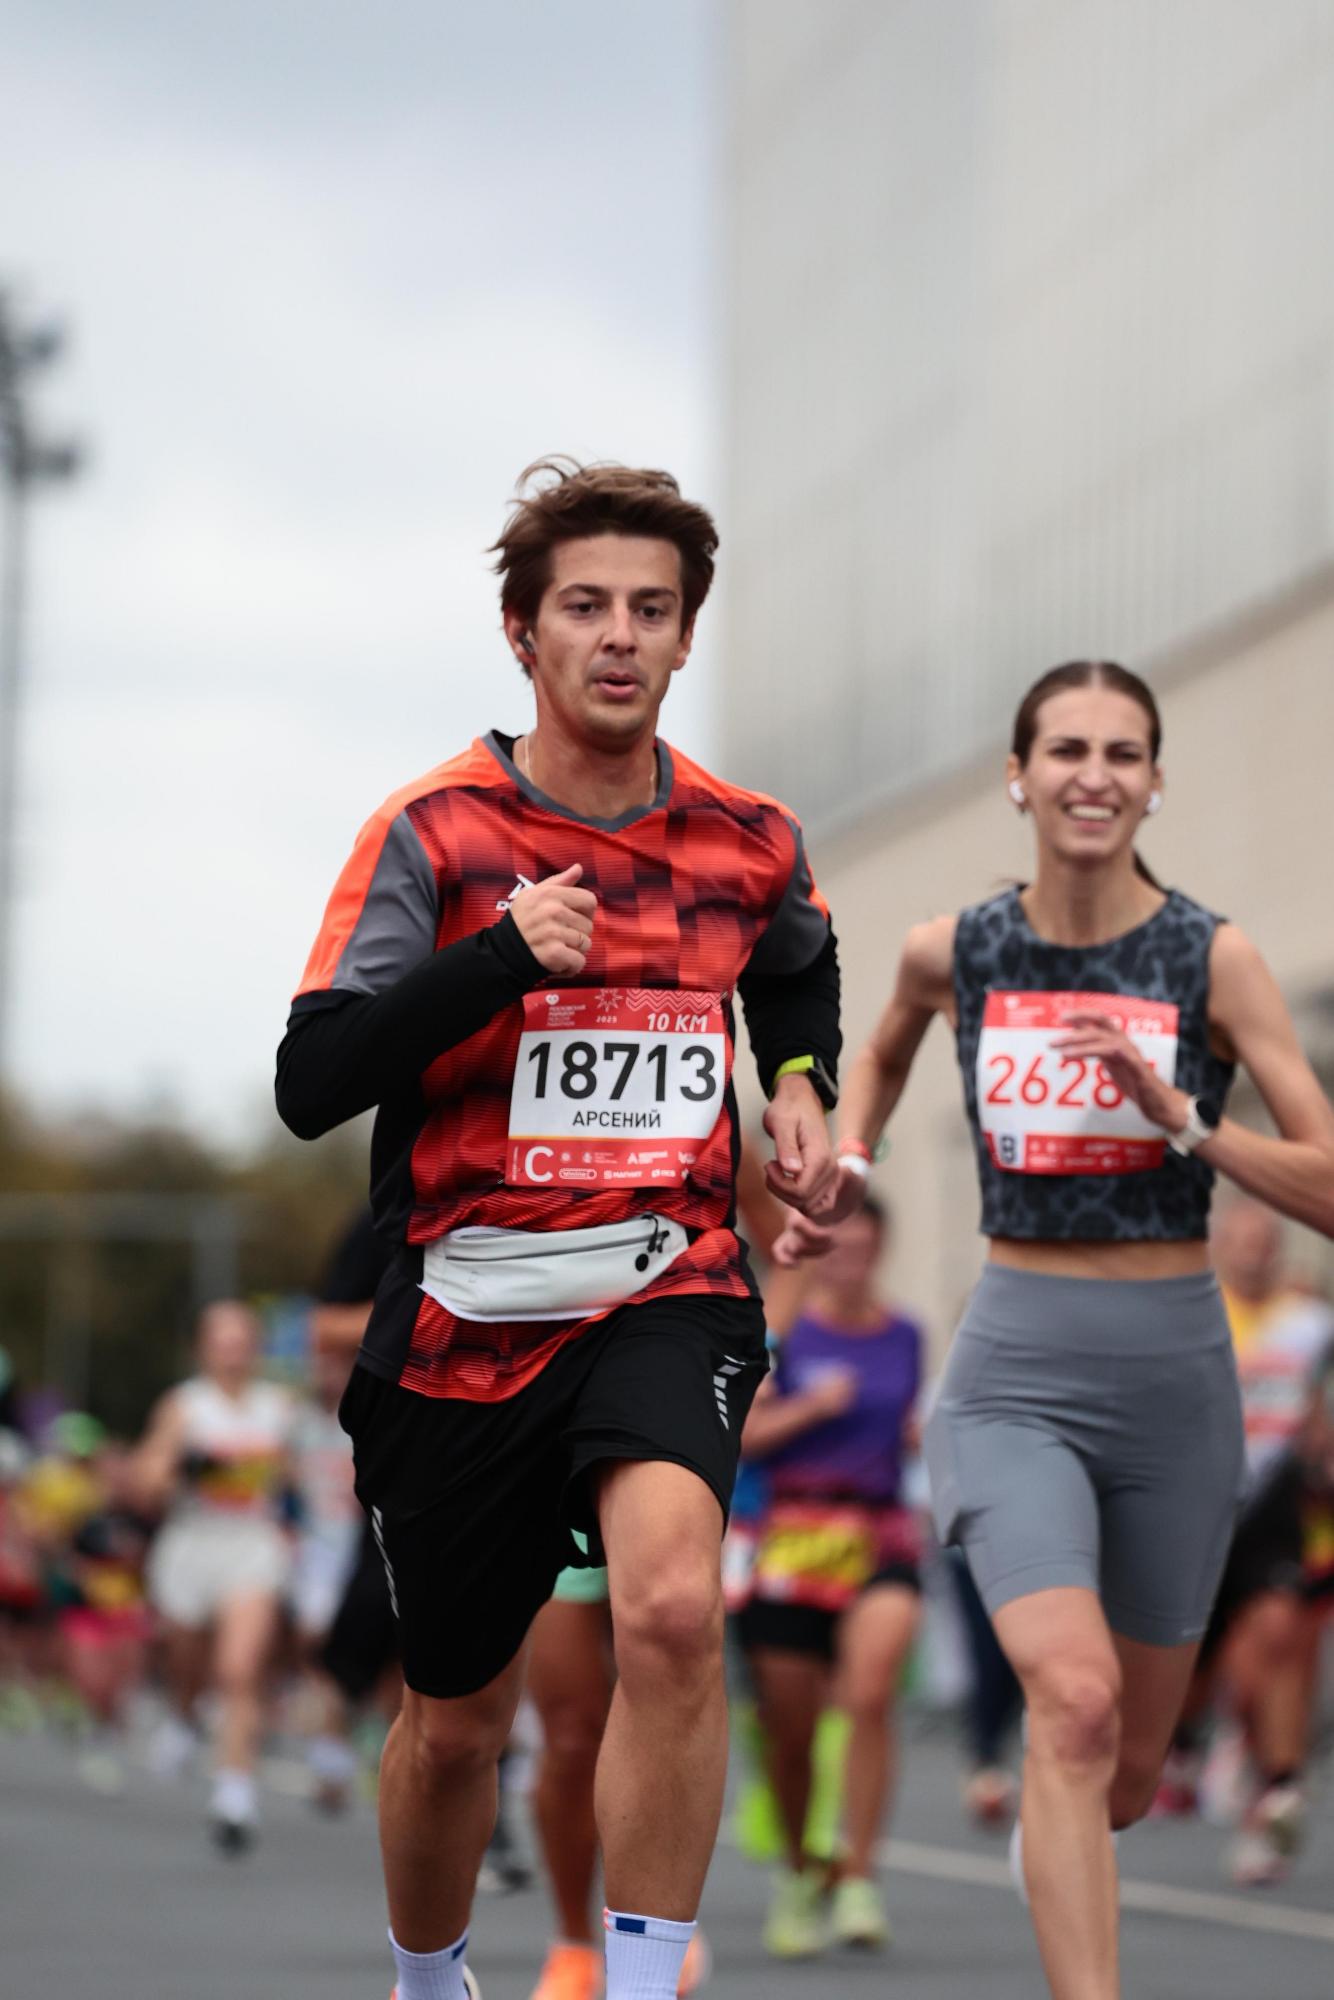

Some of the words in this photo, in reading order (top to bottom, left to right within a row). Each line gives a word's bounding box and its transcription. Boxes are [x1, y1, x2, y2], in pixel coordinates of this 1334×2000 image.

[647, 1013, 669, 1032] 10
[528, 1041, 717, 1102] 18713
[986, 1055, 1156, 1110] 2628
[572, 1110, 661, 1128] АРСЕНИЙ
[525, 1145, 554, 1183] C
[1000, 1135, 1017, 1164] B
